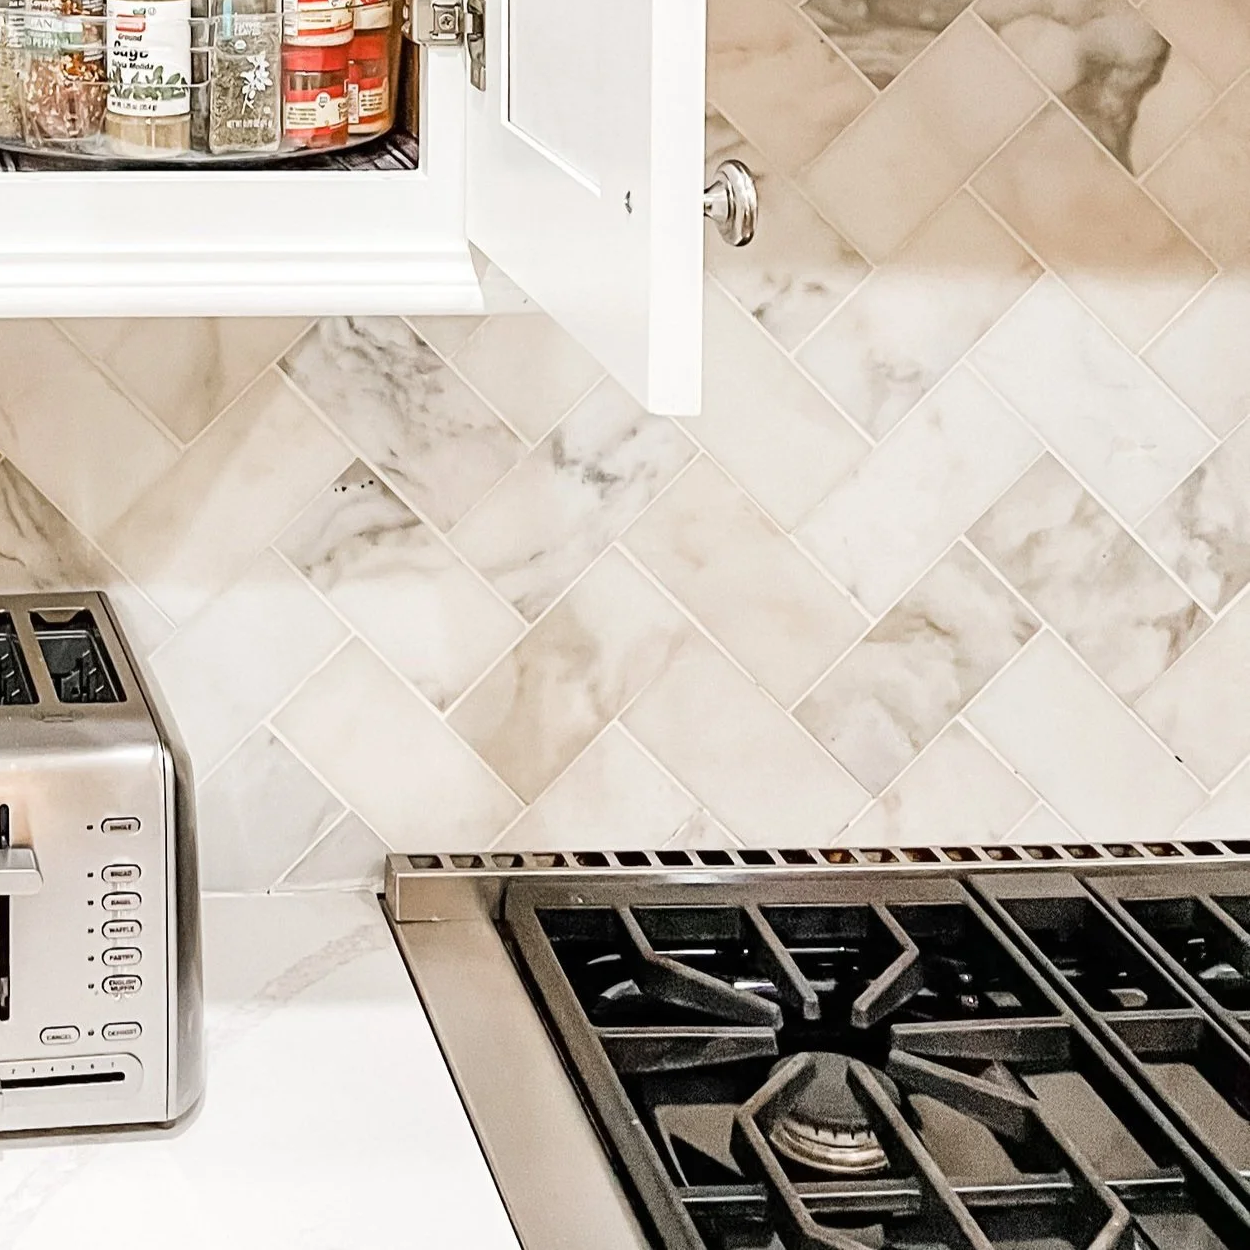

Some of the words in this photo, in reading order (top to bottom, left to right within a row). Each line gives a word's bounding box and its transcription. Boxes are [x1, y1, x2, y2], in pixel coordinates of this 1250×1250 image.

[117, 32, 143, 42] Ground
[109, 926, 135, 934] WAFFLE
[109, 953, 135, 961] PASTRY
